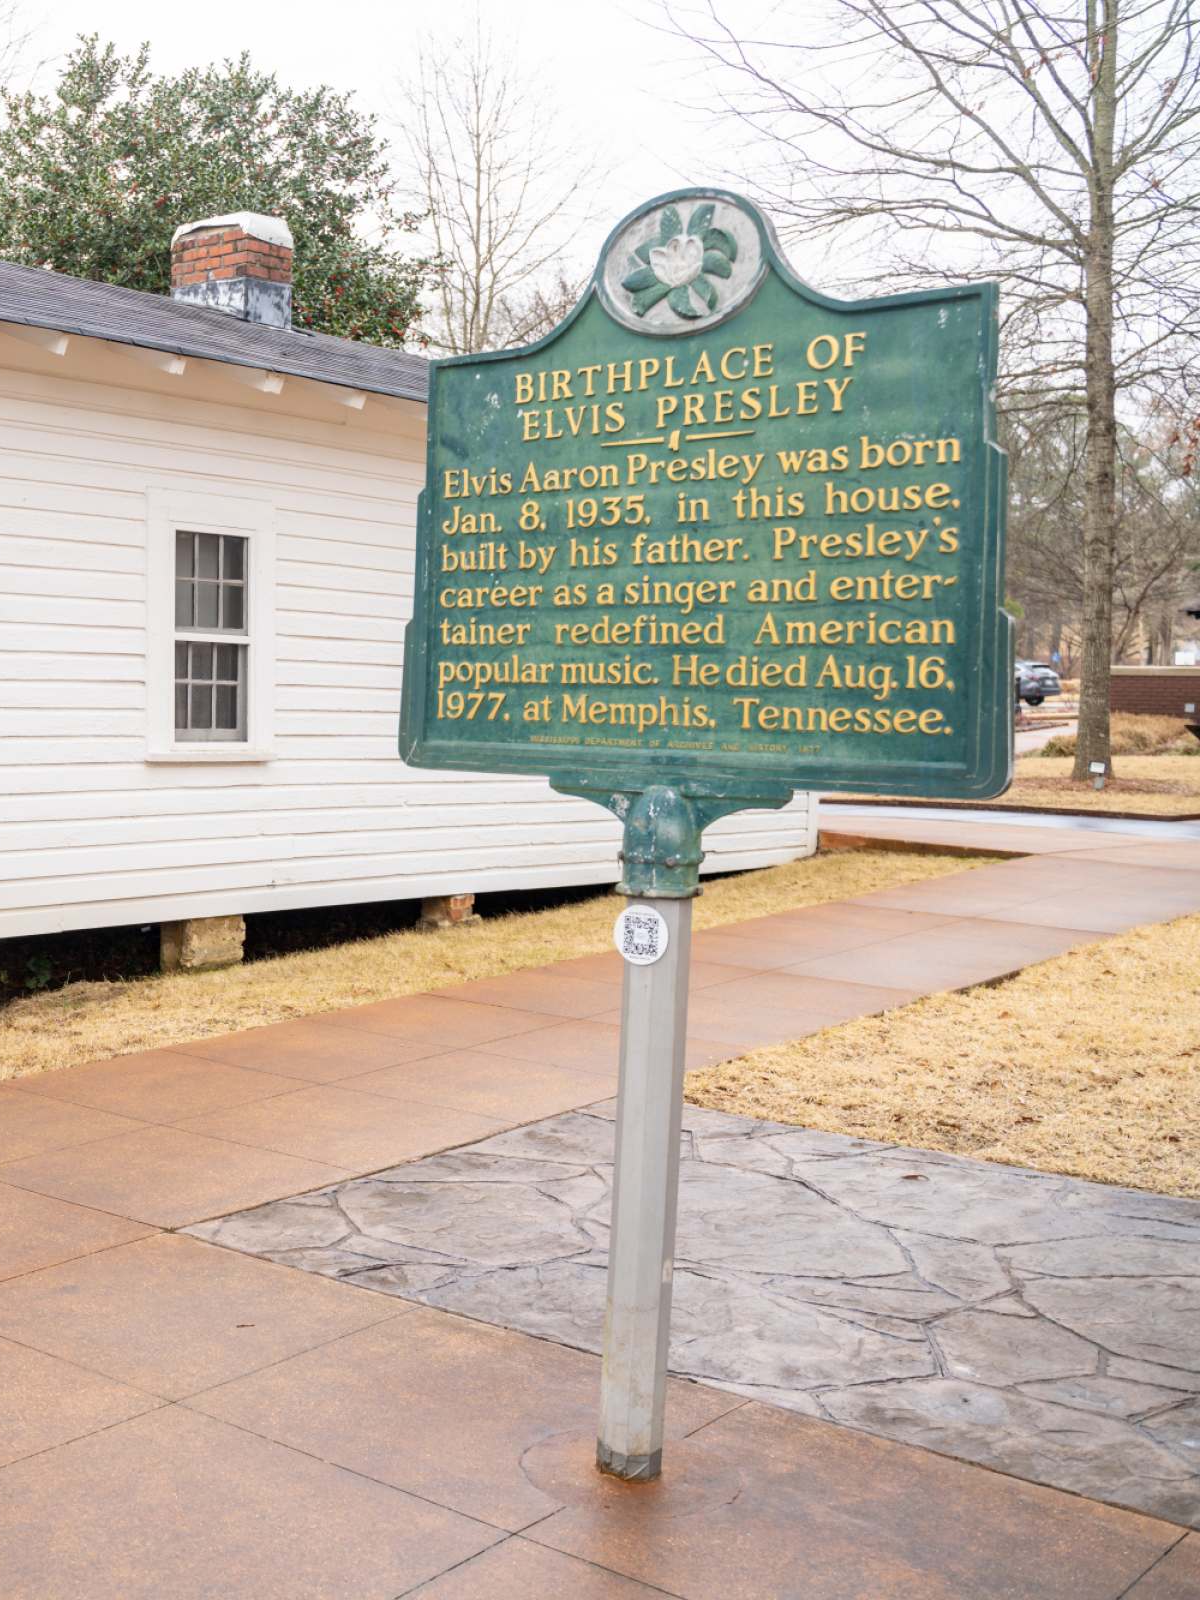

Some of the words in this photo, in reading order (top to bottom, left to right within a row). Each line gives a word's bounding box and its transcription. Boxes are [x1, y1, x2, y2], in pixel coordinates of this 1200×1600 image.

[515, 344, 774, 403] BIRTHPLACE
[806, 332, 867, 370] OF
[522, 402, 625, 441] ELVIS
[656, 377, 853, 428] PRESLEY
[443, 468, 512, 499] Elvis
[519, 461, 619, 493] Aaron
[627, 448, 764, 485] Presley
[776, 445, 848, 473] was
[860, 436, 960, 469] born
[442, 506, 502, 535] Jan.
[566, 494, 651, 528] 1935,
[678, 492, 709, 522] in
[732, 486, 804, 519] this
[441, 541, 508, 572] built
[518, 541, 557, 574] by
[569, 537, 618, 567] his
[632, 533, 749, 565] father.
[772, 517, 959, 560] Presley's
[440, 582, 543, 608] career
[553, 582, 587, 606] as
[596, 583, 614, 605] a
[624, 576, 735, 614] singer
[747, 570, 817, 602] and
[830, 569, 958, 600] enter-
[440, 618, 530, 645] tainer
[555, 614, 725, 645] redefined
[753, 612, 955, 645] American
[437, 655, 553, 689] popular
[560, 655, 659, 685] music.
[672, 655, 720, 686] He
[726, 656, 806, 687] died
[815, 655, 898, 700] Aug.
[905, 656, 955, 692] 16,
[523, 696, 552, 721] at
[733, 697, 953, 735] Tennessee.
